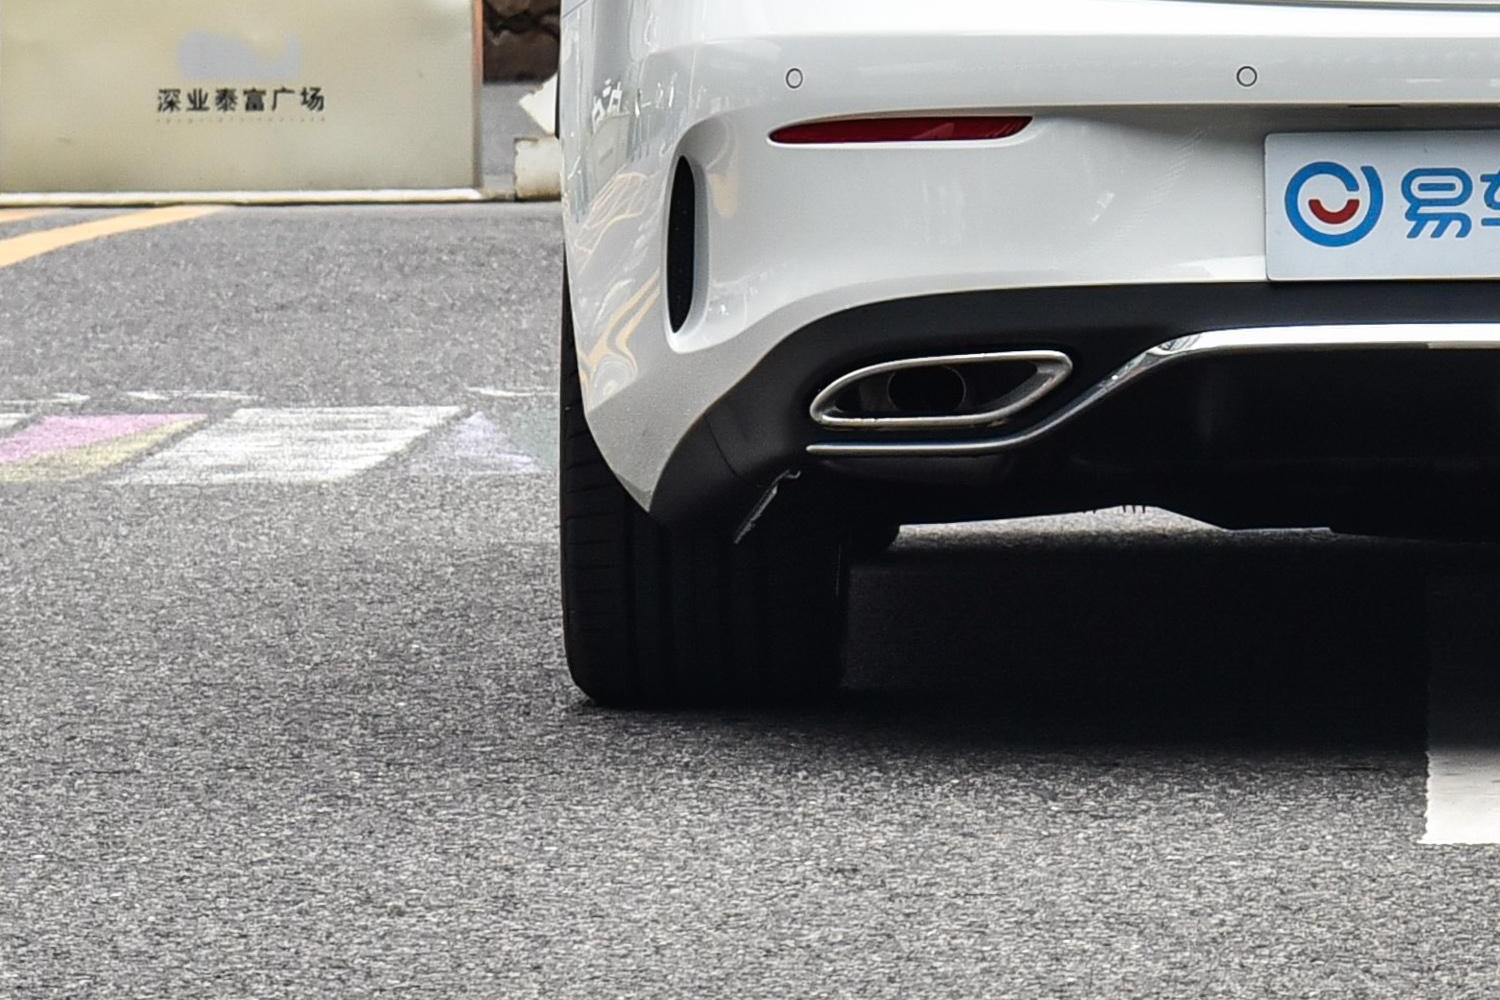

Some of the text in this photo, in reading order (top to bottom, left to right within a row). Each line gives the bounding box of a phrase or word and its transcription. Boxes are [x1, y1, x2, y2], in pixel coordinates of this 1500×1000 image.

[157, 86, 326, 113] 深业泰富广场
